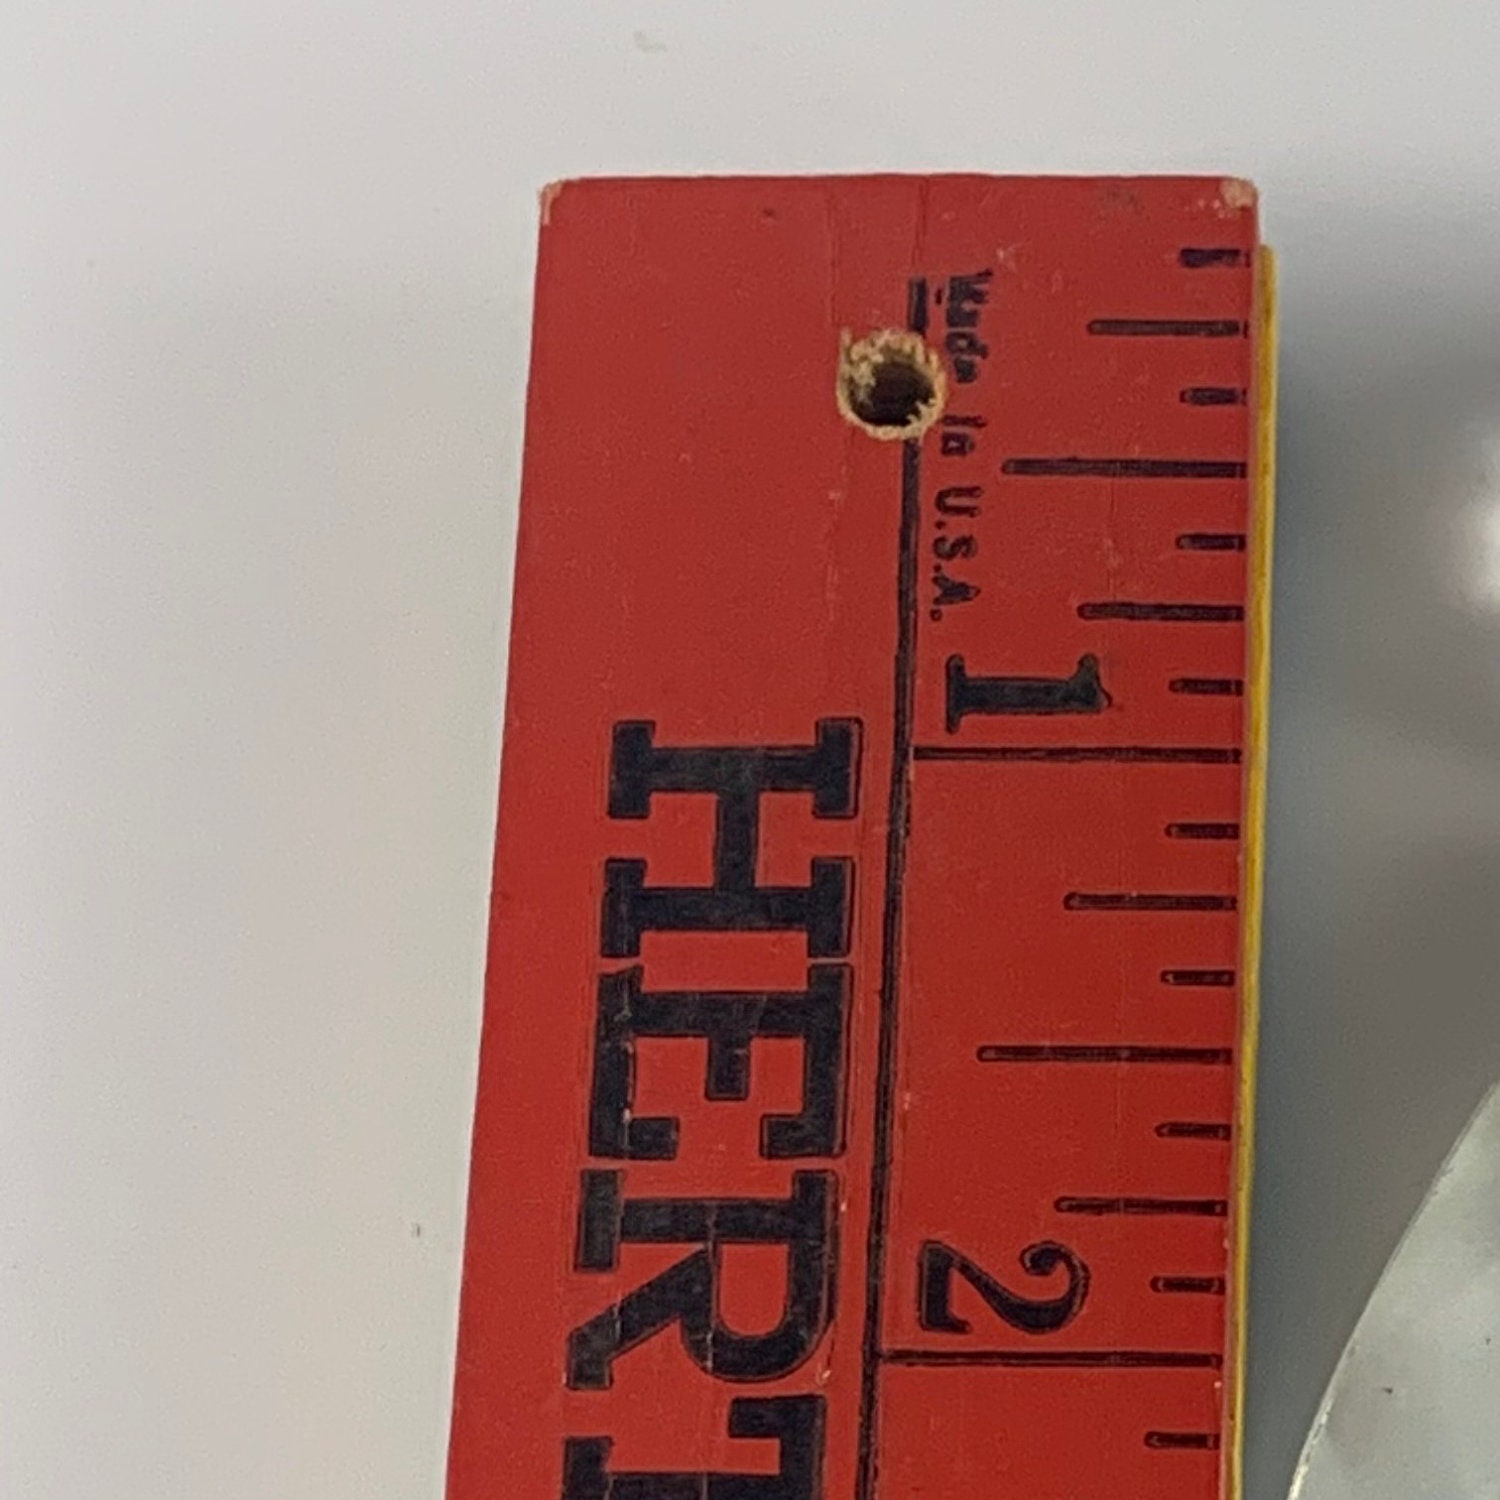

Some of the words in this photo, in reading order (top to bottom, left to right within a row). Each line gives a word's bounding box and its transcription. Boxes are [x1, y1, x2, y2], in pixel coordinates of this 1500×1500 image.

[928, 485, 982, 623] U.S.A.
[942, 653, 1112, 735] 1
[917, 1240, 1091, 1335] 2
